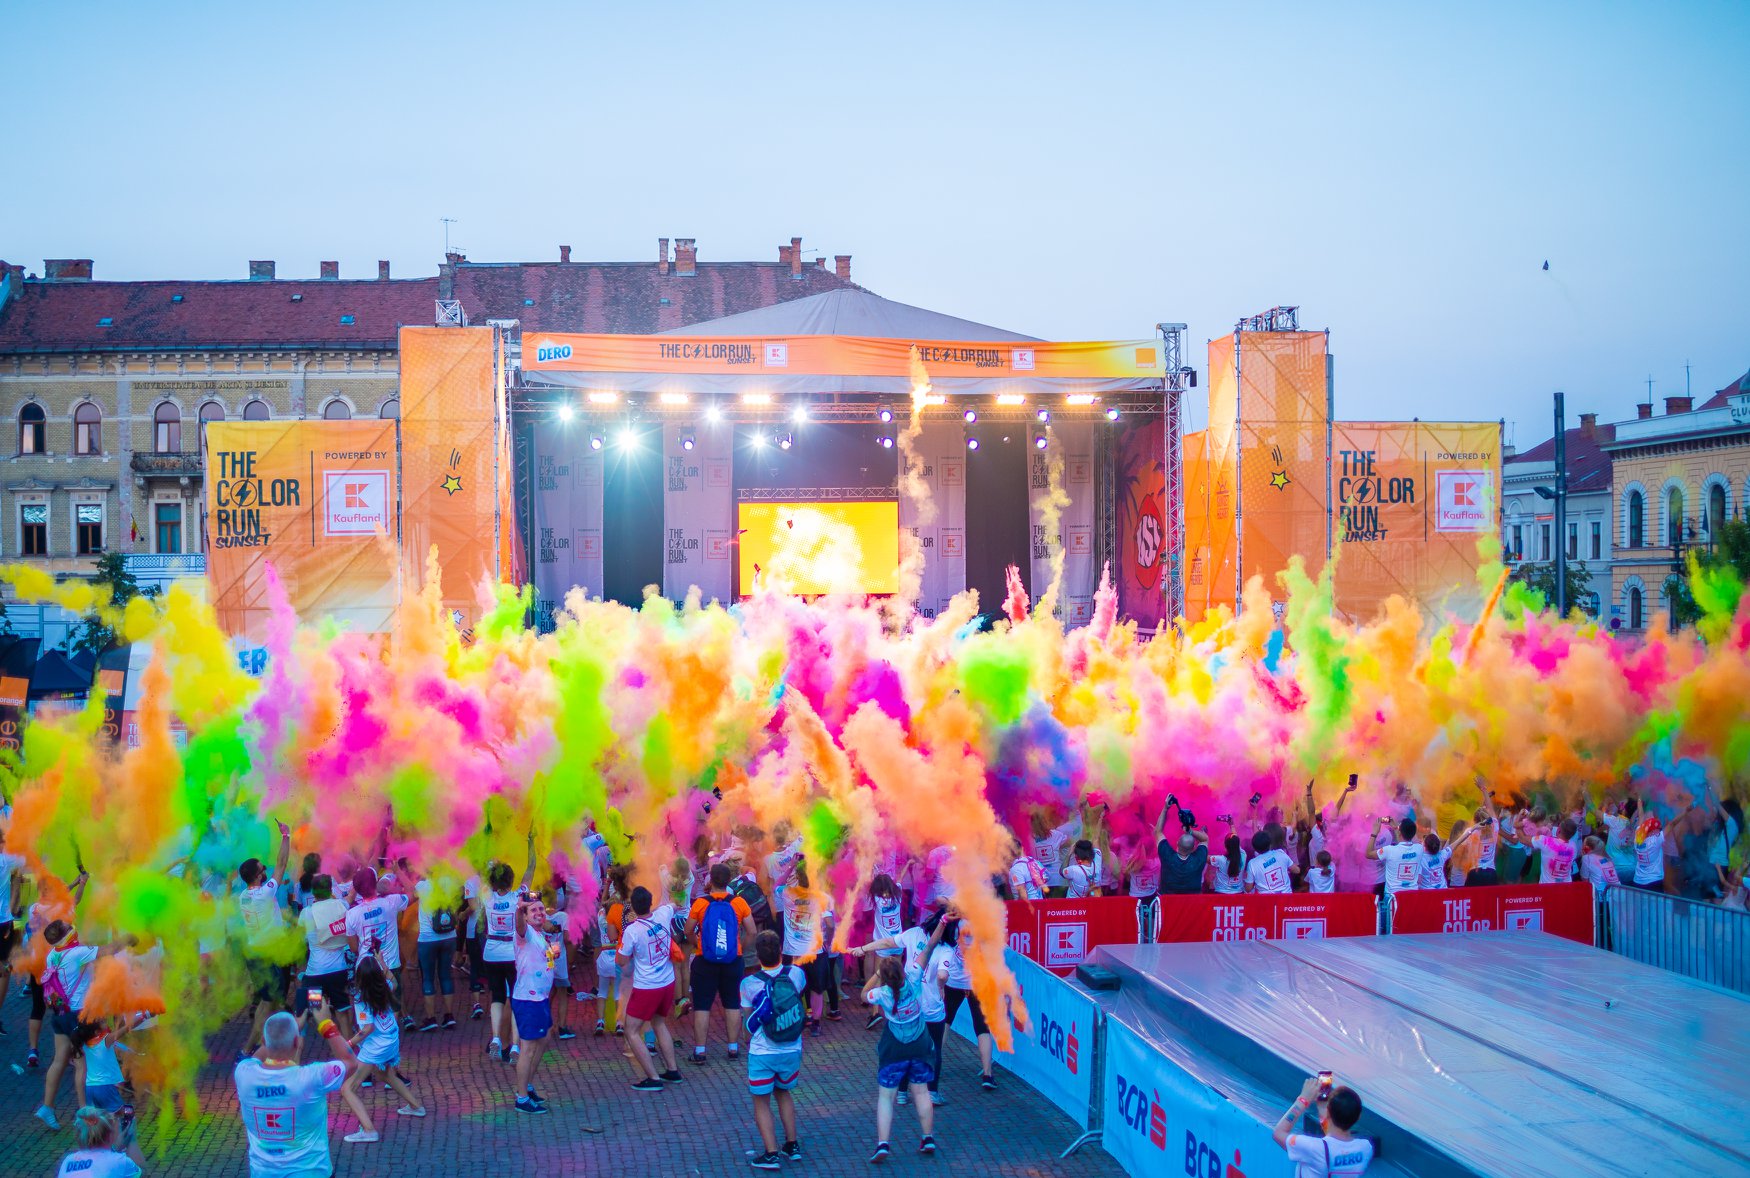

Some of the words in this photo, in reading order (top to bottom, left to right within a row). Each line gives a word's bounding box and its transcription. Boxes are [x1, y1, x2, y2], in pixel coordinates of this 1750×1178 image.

[538, 345, 571, 361] DERO
[659, 344, 681, 358] THE
[728, 344, 752, 358] RUN
[977, 349, 999, 362] RUN
[727, 357, 756, 365] SUNSET
[325, 452, 372, 460] POWERED
[374, 451, 387, 459] BY
[1340, 450, 1376, 476] THE
[1437, 452, 1478, 460] POWERED
[1481, 452, 1491, 460] BY
[217, 451, 257, 478] THE
[217, 478, 300, 508] COLOR
[1339, 476, 1415, 506] COLOR
[217, 509, 260, 536] RUN
[333, 513, 381, 523] Kaufland
[1339, 505, 1378, 534] RUN
[215, 533, 271, 549] SUNSET
[541, 528, 554, 538] THE
[669, 529, 683, 538] THE
[541, 549, 555, 559] RUN
[669, 550, 684, 560] RUN
[1213, 906, 1245, 928] THE
[1443, 899, 1471, 921] THE
[776, 1003, 800, 1032] NIKE
[1041, 1012, 1065, 1064] BCR
[257, 1085, 286, 1098] DERO
[1116, 1074, 1148, 1137] BCR
[66, 1159, 93, 1173] DERO
[1334, 1151, 1363, 1167] DERO
